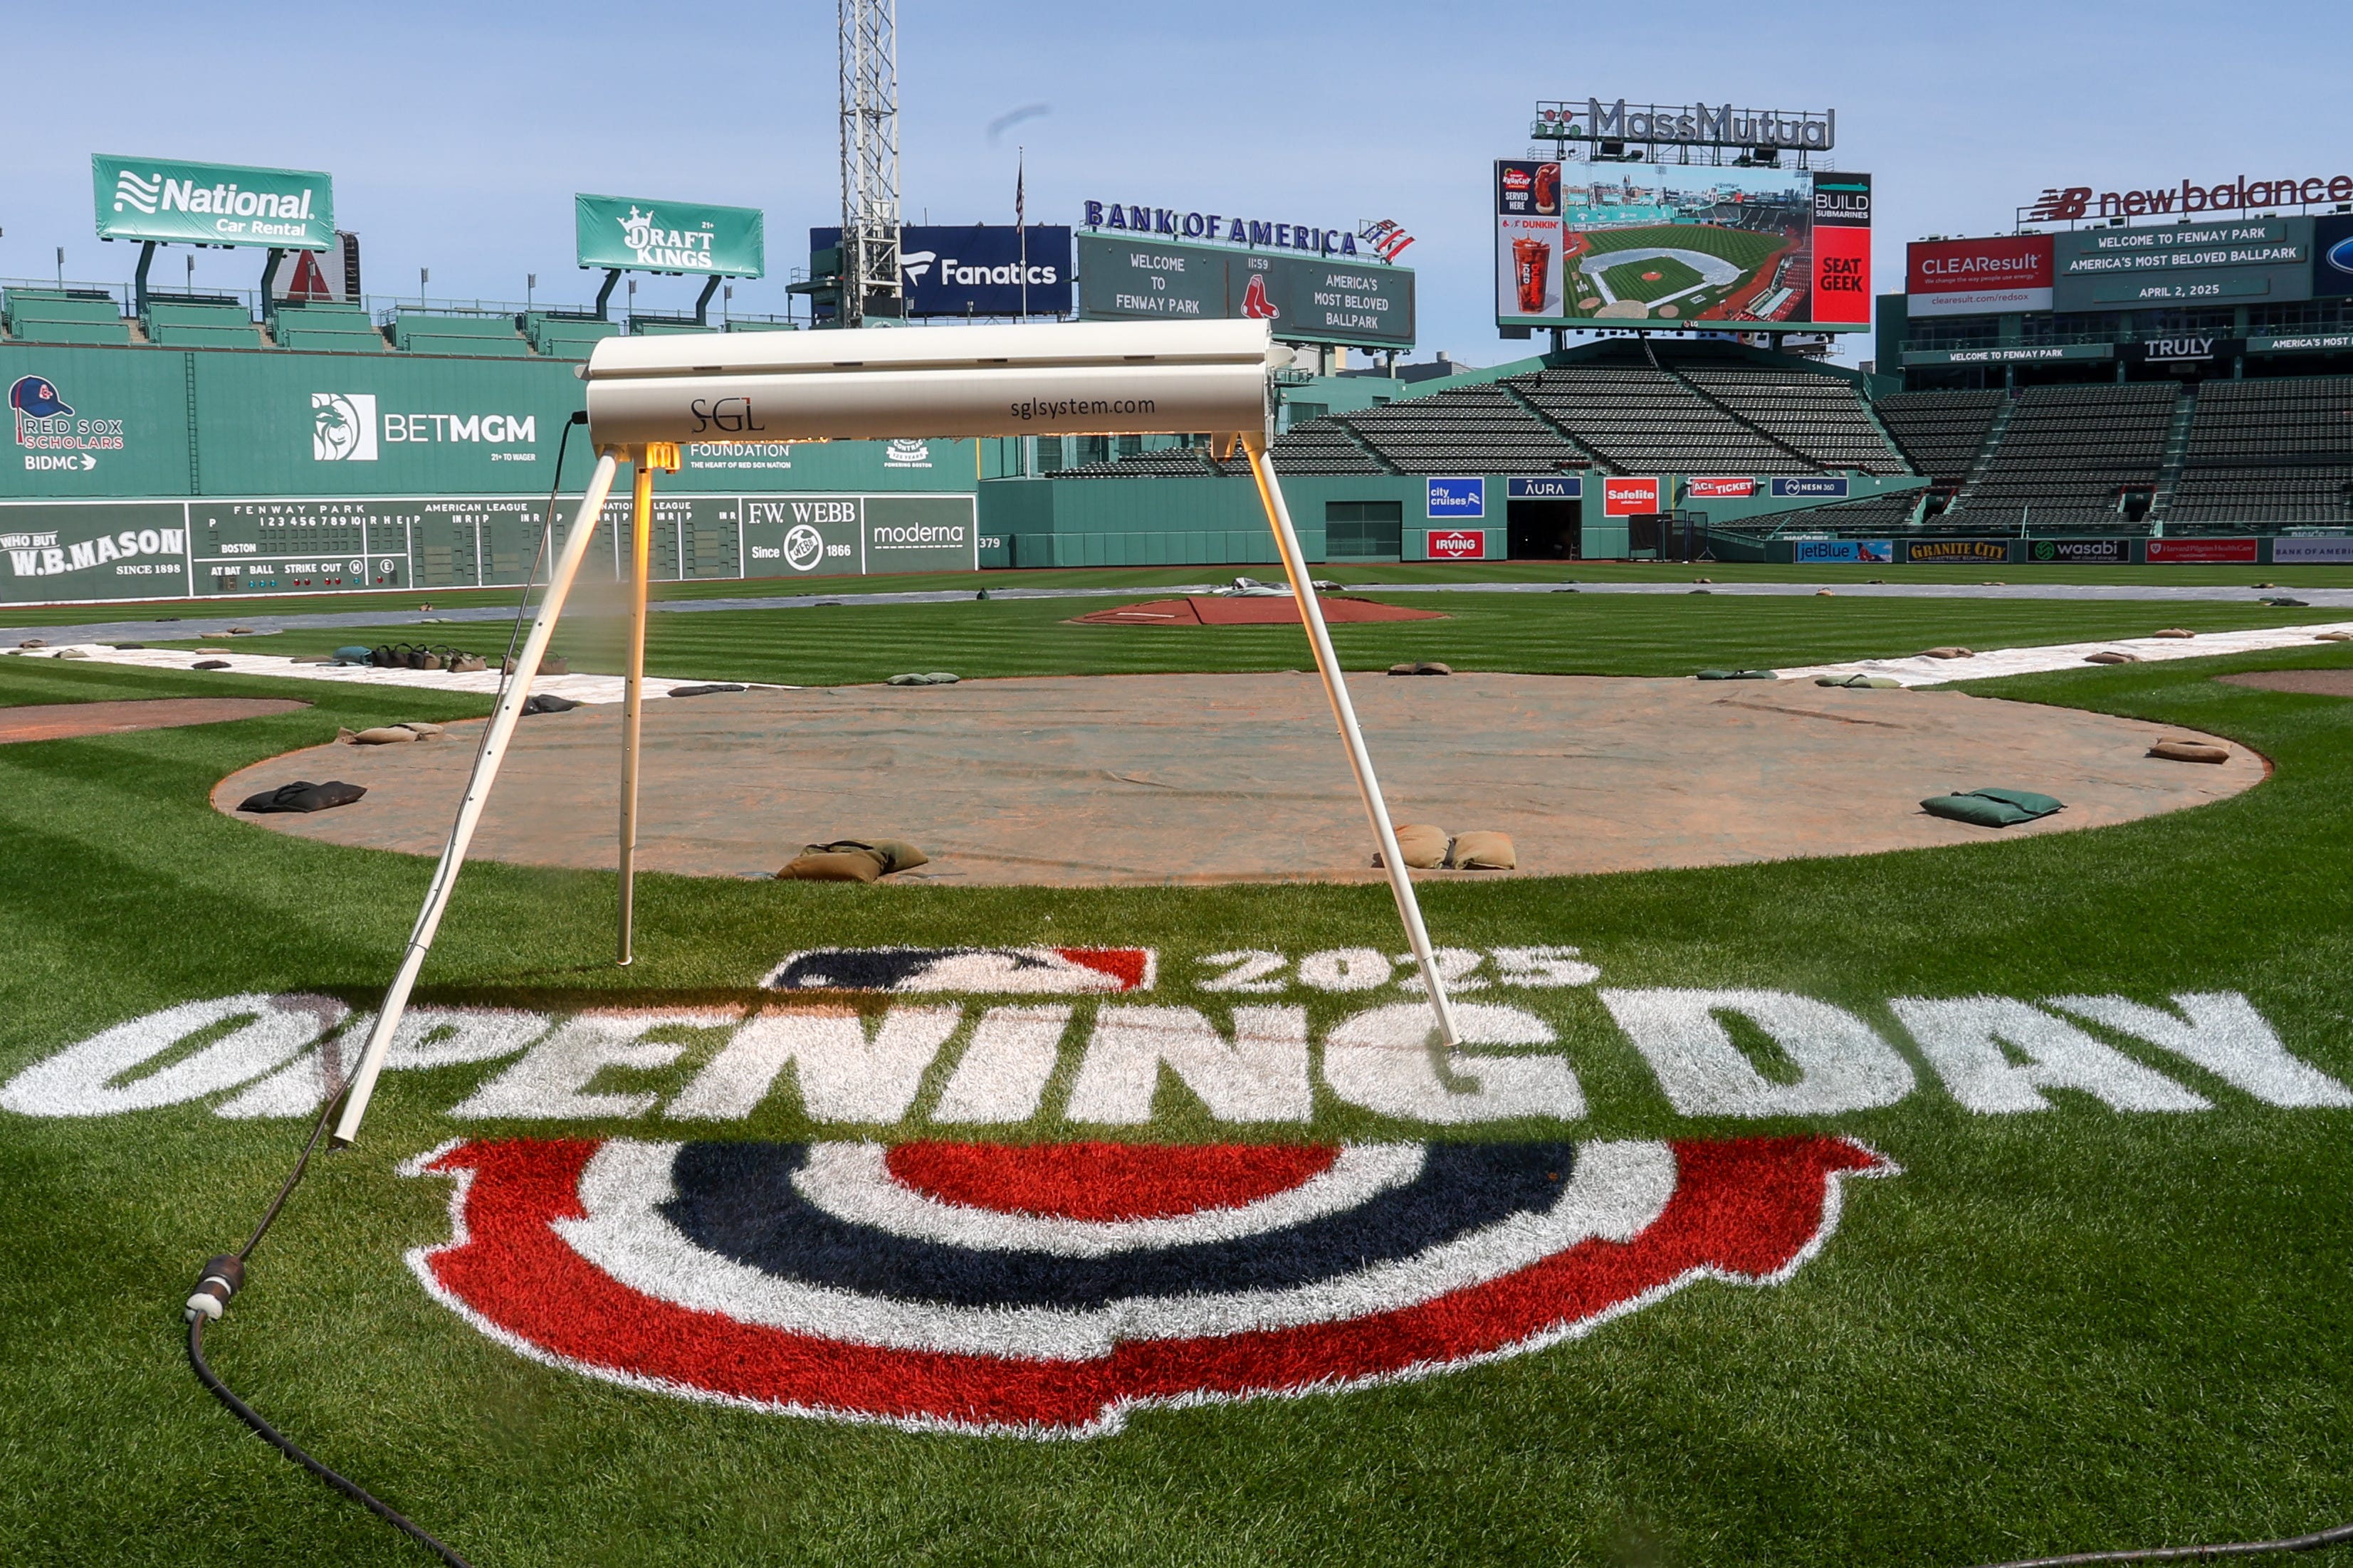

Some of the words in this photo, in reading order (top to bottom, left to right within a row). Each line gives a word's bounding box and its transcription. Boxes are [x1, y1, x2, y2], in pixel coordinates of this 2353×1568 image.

[1588, 97, 1835, 149] MassMutual
[1505, 191, 1529, 201] SERVED
[1815, 194, 1868, 210] BUILD
[2100, 188, 2176, 216] new
[2182, 175, 2353, 213] balance
[1509, 201, 1525, 210] HERE
[1815, 210, 1868, 219] SUBMARINES
[216, 219, 246, 233] Car
[251, 221, 305, 236] Rental
[1084, 200, 1175, 234] BANK
[1183, 212, 1222, 239] OF
[1229, 218, 1358, 256] AMERICA
[624, 226, 714, 249] DRAFT
[2099, 234, 2154, 248] WELCOME
[2158, 233, 2173, 244] TO
[2176, 230, 2228, 243] FENWAY
[2232, 227, 2265, 240] PARK
[637, 246, 713, 268] KINGS
[1131, 253, 1185, 272] WELCOME
[1247, 258, 1269, 270] 11:59
[1922, 253, 2038, 275] CLEAResult
[2070, 256, 2132, 270] AMERICA'S
[2135, 255, 2168, 267] MOST
[2171, 251, 2226, 265] BELOVED
[2231, 247, 2296, 261] BALLPARK
[941, 259, 1057, 285] Fanatics
[1823, 258, 1862, 274] SEAT
[1151, 277, 1165, 290] TO
[1326, 274, 1378, 291] AMERICA'S
[1820, 275, 1862, 293] GEEK
[1932, 293, 2028, 305] clearesult.com/redsox
[2139, 287, 2171, 298] APRIL
[2175, 286, 2186, 298] 2,
[2189, 284, 2220, 295] 2025
[1116, 294, 1165, 312] FENWAY
[1168, 298, 1200, 315] PARK
[1314, 293, 1342, 307] MOST
[1345, 295, 1388, 311] BELOVED
[1326, 313, 1378, 330] BALLPARK
[2144, 337, 2214, 356] TRULY
[2272, 338, 2320, 348] AMERICA'S
[2323, 337, 2348, 346] MOST
[1950, 352, 1988, 361] WELCOME
[2003, 350, 2038, 359] FENWAY
[2040, 349, 2063, 357] PARK
[691, 396, 765, 434] SGL
[1011, 397, 1155, 420] sglsystem.com
[23, 419, 70, 434] RED
[78, 419, 123, 435] SOX
[384, 414, 535, 443] BETMGM
[23, 436, 124, 449] SCHOLARS
[691, 443, 789, 457] FOUNDATION
[25, 456, 78, 470] BIDMC
[503, 453, 512, 461] TO
[513, 453, 536, 461] WAGER
[1430, 488, 1450, 498] city
[1608, 490, 1655, 500] Safelite
[1694, 482, 1714, 491] ACE
[1716, 482, 1752, 494] TICKET
[1430, 496, 1467, 506] cruises
[234, 505, 305, 515] FENWAY
[320, 505, 365, 514] PARK
[748, 503, 785, 524] F.W.
[790, 502, 856, 523] WEBB
[209, 518, 216, 527] P
[351, 516, 361, 525] 10
[370, 516, 377, 525] R
[874, 522, 963, 543] moderna
[1, 535, 30, 548] WHO
[33, 534, 57, 546] BUT
[221, 543, 256, 553] BOSTON
[794, 539, 814, 557] WEBB
[979, 538, 1000, 548] 379
[1436, 539, 1475, 550] IRVING
[2057, 541, 2117, 554] wasabi
[752, 545, 780, 559] Since
[826, 544, 851, 557] 1866
[1800, 543, 1850, 561] jetBlue
[1912, 542, 1971, 559] GRANITE
[1974, 542, 2006, 559] CITY
[116, 565, 152, 575] SINCE
[155, 564, 181, 574] 1898
[211, 567, 223, 576] AT
[224, 566, 241, 575] BAT
[250, 565, 274, 574] BALL
[285, 564, 318, 574] STRIKE
[321, 563, 342, 572] OUT
[1194, 945, 1601, 994] 2025
[0, 991, 1589, 1125] OPENING
[1597, 986, 2353, 1118] DAY
